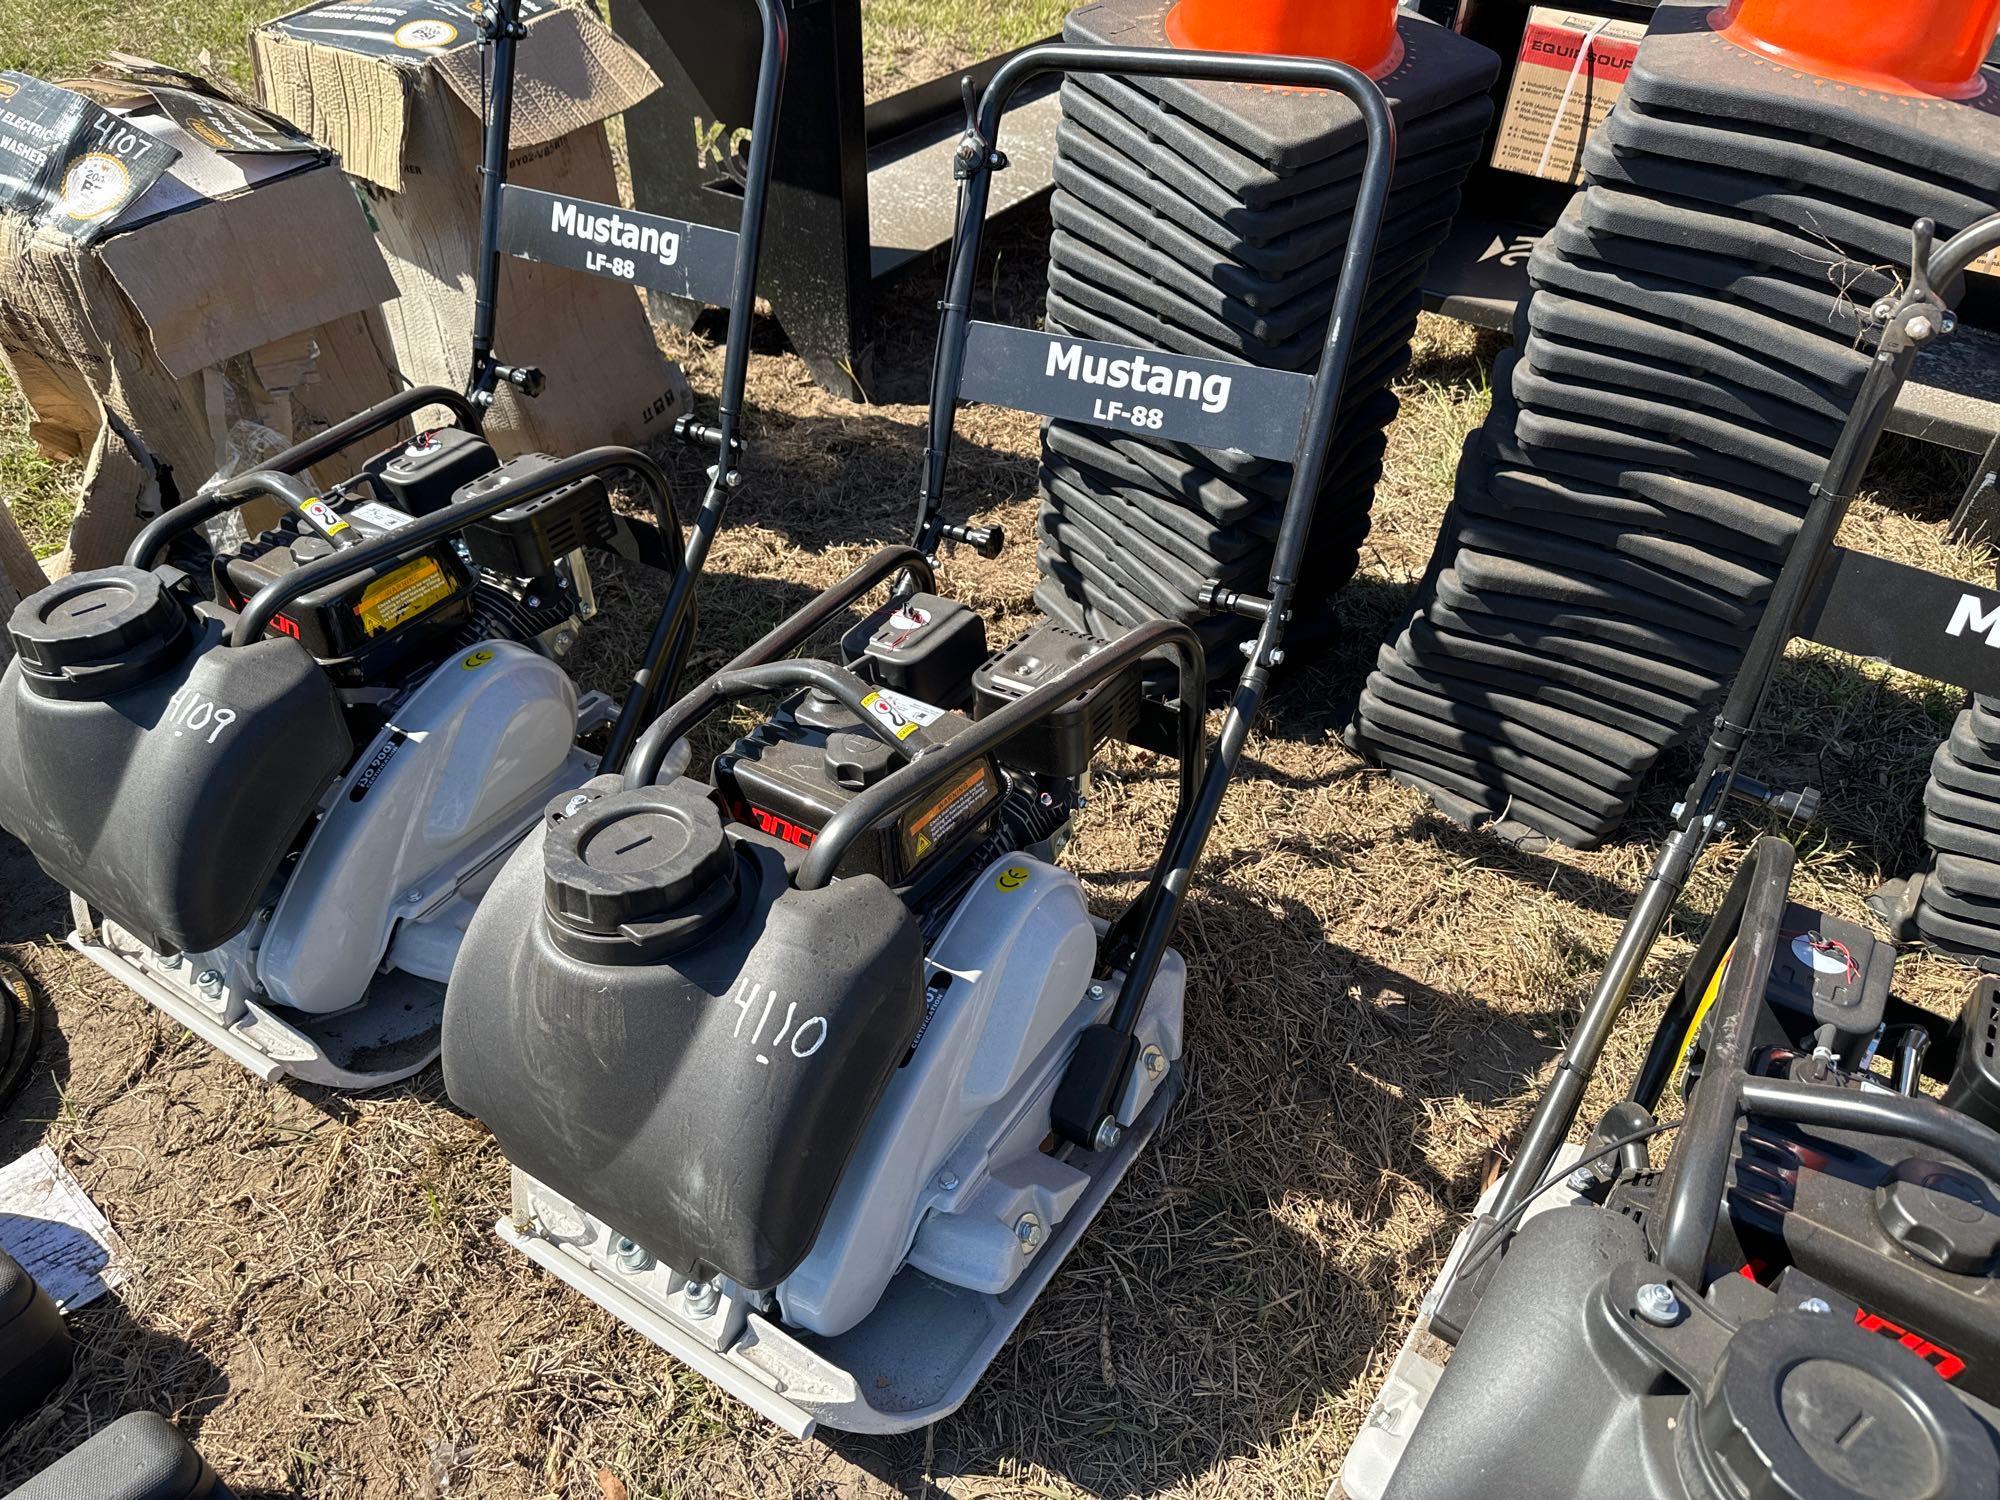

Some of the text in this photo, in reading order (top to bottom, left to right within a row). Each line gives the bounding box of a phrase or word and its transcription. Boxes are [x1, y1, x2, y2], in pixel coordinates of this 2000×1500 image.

[0, 134, 48, 167] WASHER
[94, 113, 153, 160] 4107
[551, 201, 680, 266] Mustang
[585, 251, 635, 279] LF-88
[1045, 341, 1232, 414] Mustang
[1093, 399, 1164, 430] LF-88
[465, 652, 492, 667] CE
[371, 740, 396, 767] 9001
[1000, 868, 1028, 888] CE
[733, 977, 828, 1060] 4110
[911, 993, 943, 1049] CERTIFICATION
